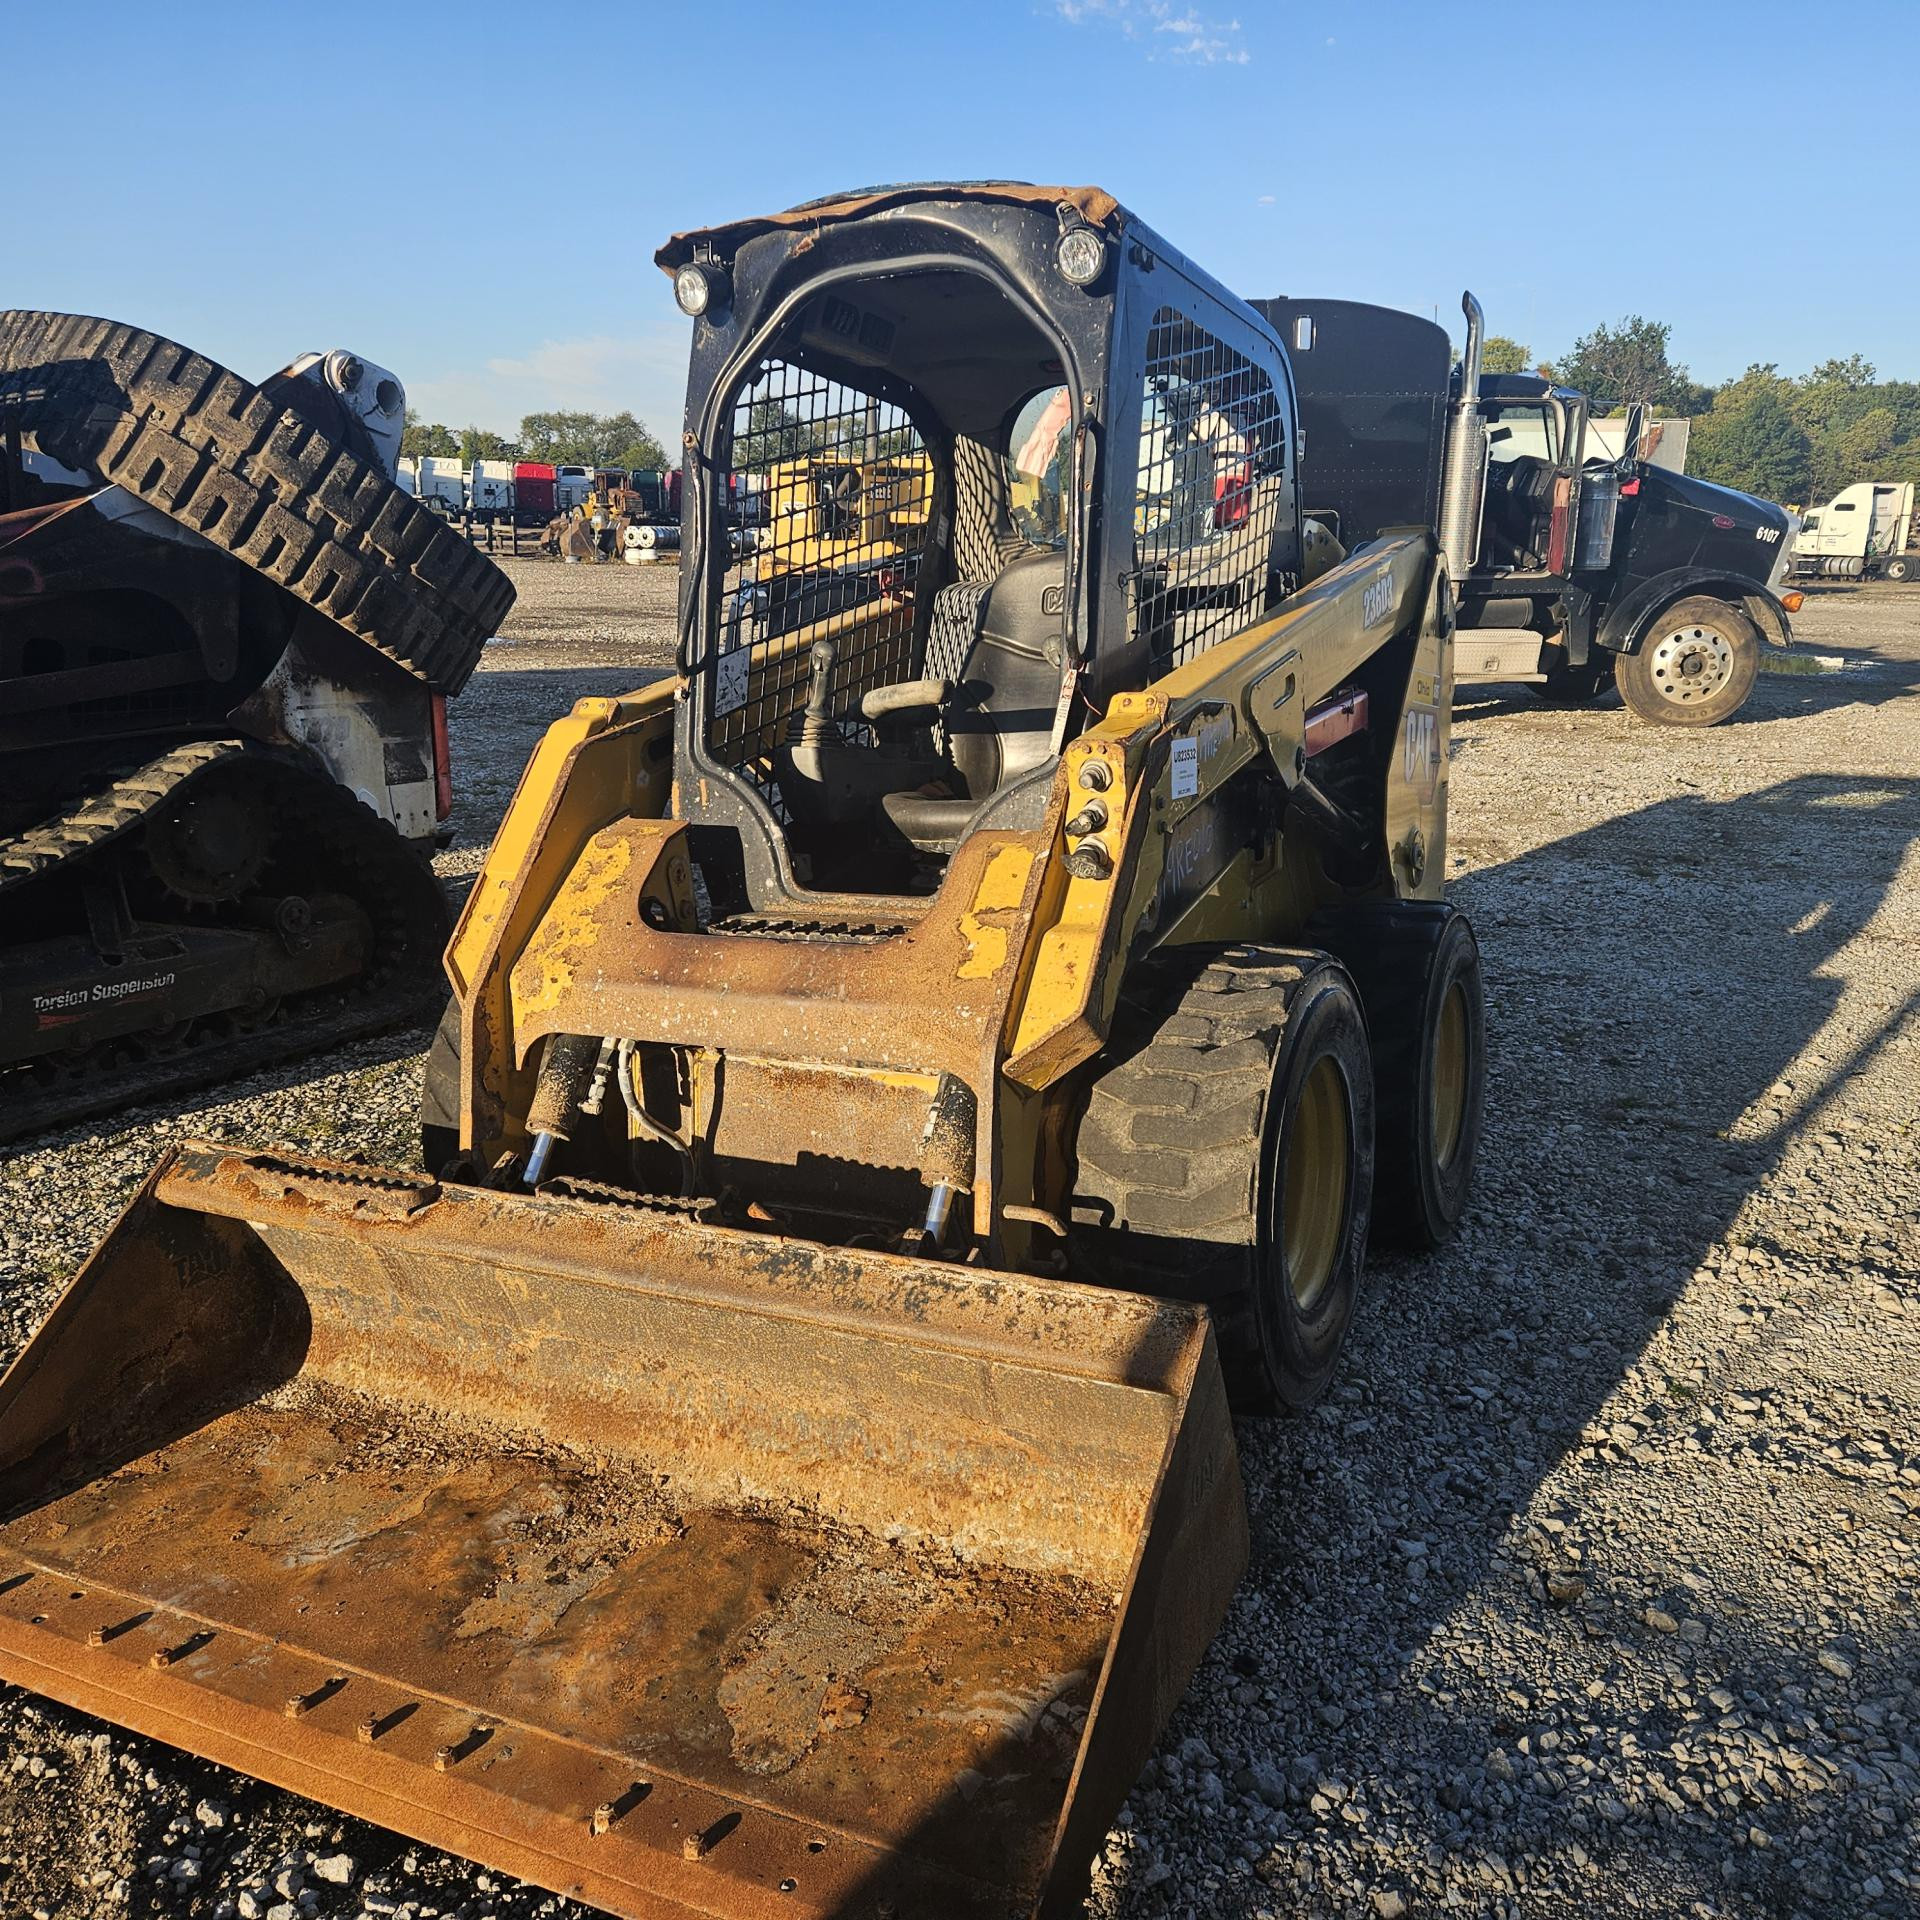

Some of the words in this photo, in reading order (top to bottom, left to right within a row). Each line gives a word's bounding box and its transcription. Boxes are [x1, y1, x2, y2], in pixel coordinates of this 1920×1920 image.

[1756, 526, 1780, 544] 6107
[1363, 574, 1393, 628] 236D3
[1405, 710, 1434, 782] CAT
[33, 990, 88, 1013] Torsion
